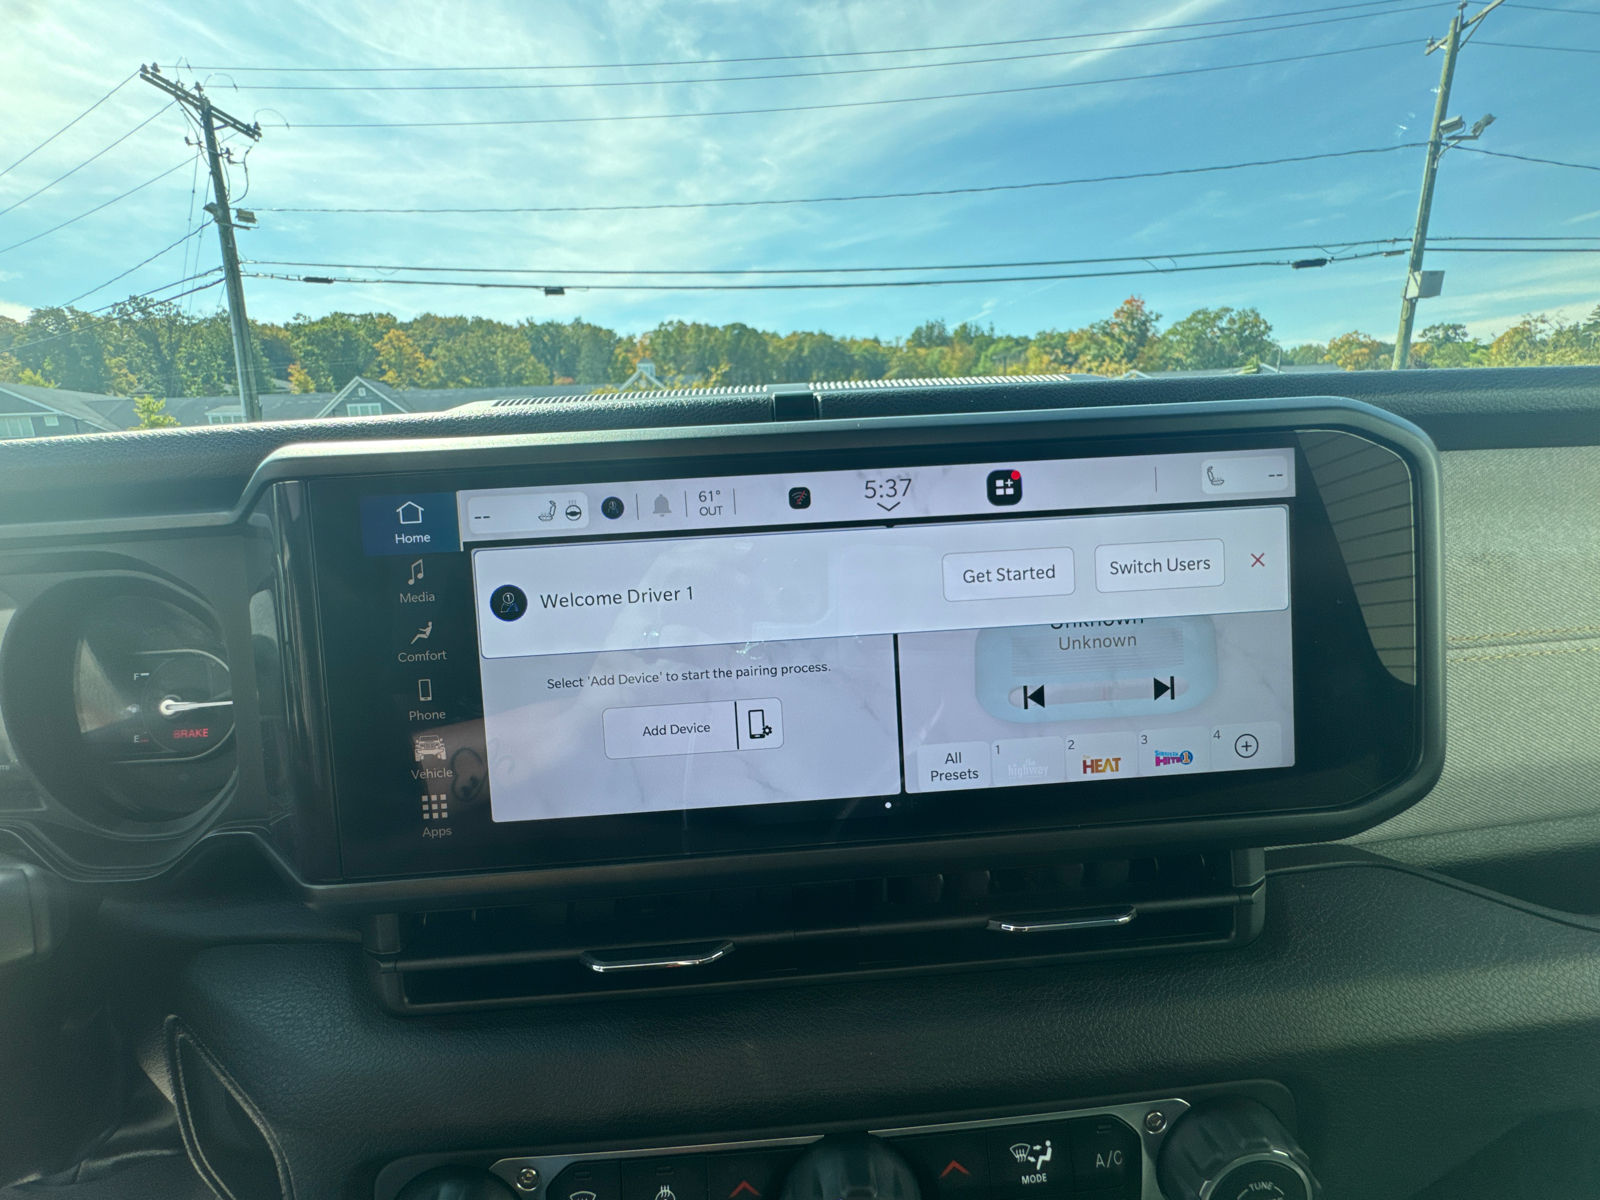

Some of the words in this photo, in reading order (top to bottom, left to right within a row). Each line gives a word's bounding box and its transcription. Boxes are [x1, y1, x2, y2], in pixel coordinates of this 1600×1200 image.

[864, 477, 913, 500] 5:37
[698, 490, 721, 503] 61°
[699, 505, 723, 516] OUT
[395, 532, 431, 545] Home
[1109, 557, 1163, 576] Switch
[1166, 556, 1211, 573] Users
[962, 568, 992, 584] Get
[996, 564, 1056, 582] Started
[400, 591, 435, 603] Media
[540, 592, 622, 608] Welcome
[627, 586, 681, 604] Driver
[687, 586, 694, 600] 1
[1058, 634, 1137, 651] Unknown
[397, 649, 447, 662] Comfort
[133, 672, 139, 680] F
[547, 677, 584, 689] Select
[665, 671, 678, 682] to
[681, 669, 710, 681] start
[713, 667, 733, 679] the
[735, 665, 778, 680] pairing
[781, 663, 831, 677] process.
[409, 708, 446, 721] Phone
[173, 728, 209, 738] BRAKE
[642, 725, 667, 737] Add
[670, 722, 711, 735] Device
[1213, 730, 1221, 740] 4
[133, 735, 139, 743] E
[1067, 739, 1075, 750] 2
[1141, 735, 1148, 745] 3
[995, 744, 1001, 755] 1
[944, 751, 962, 764] All
[1083, 757, 1121, 774] HEAT
[411, 766, 453, 779] Vehicle
[930, 767, 979, 783] Presets
[422, 825, 452, 839] Apps
[1096, 1150, 1123, 1168] A/C
[1021, 1173, 1047, 1185] MODE
[1249, 1181, 1274, 1191] TUNE
